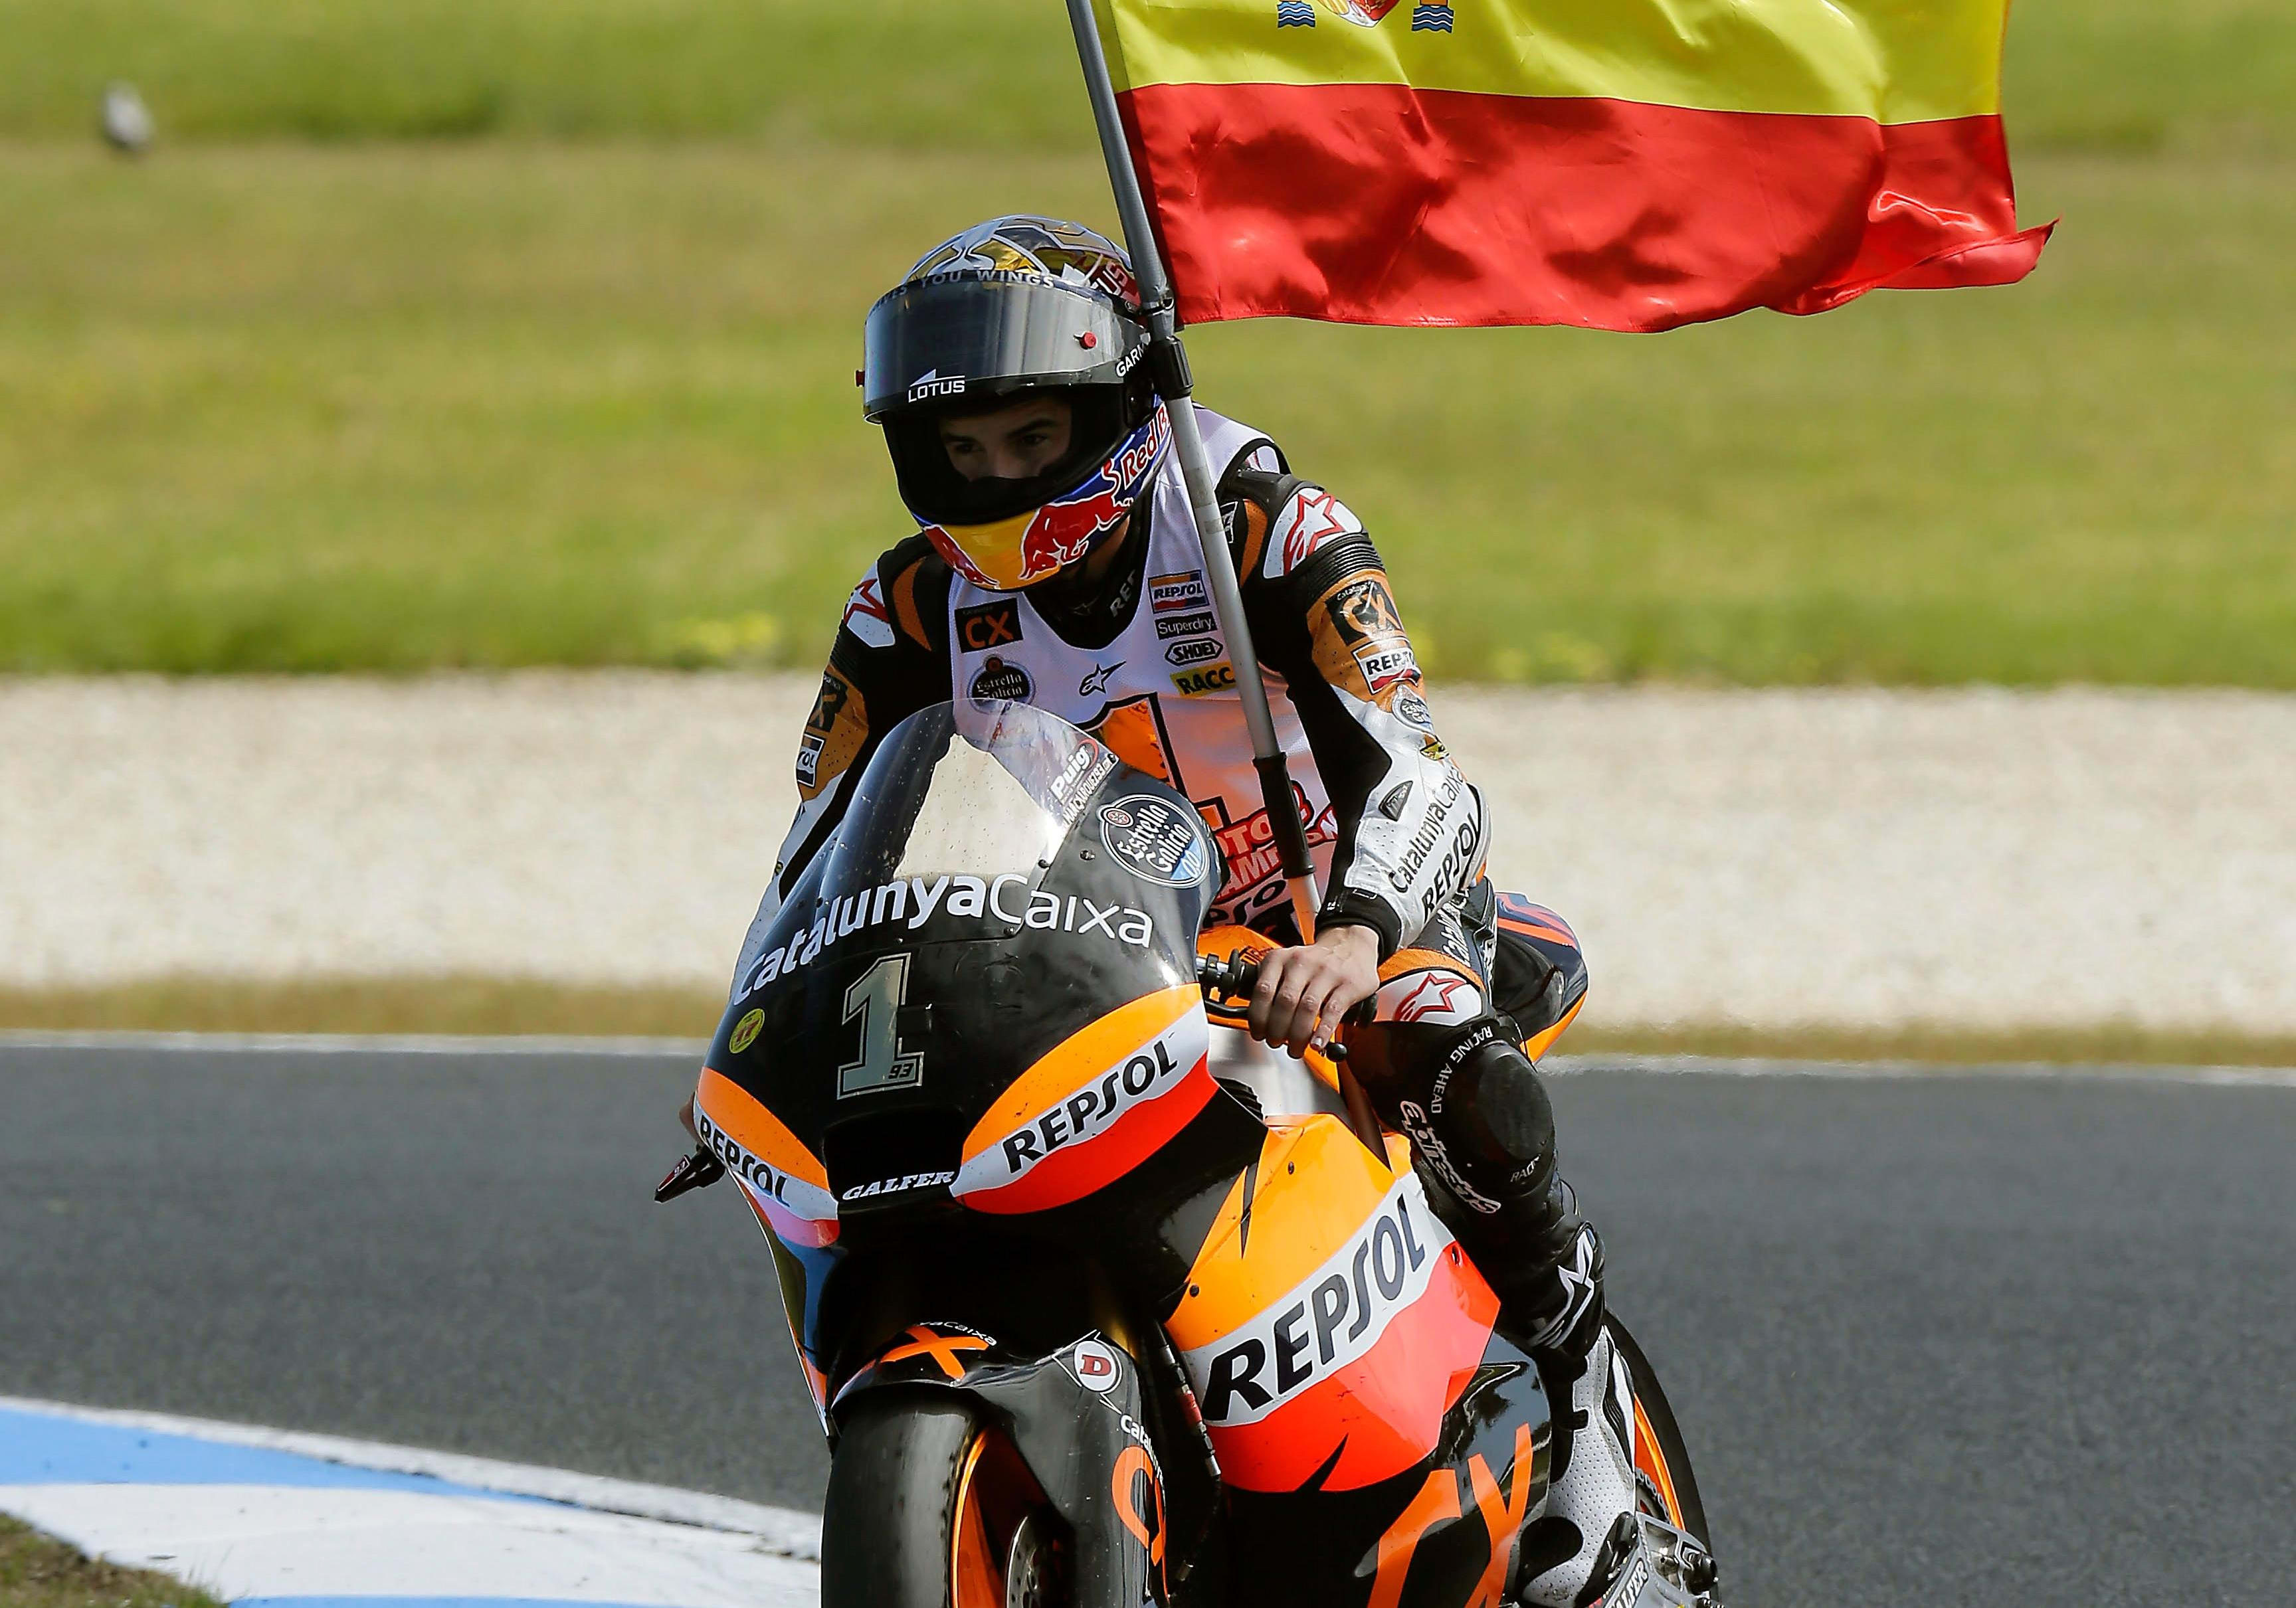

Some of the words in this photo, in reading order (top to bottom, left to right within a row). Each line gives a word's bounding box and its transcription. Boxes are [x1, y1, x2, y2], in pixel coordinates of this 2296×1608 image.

[921, 270, 963, 288] YOU
[977, 270, 1056, 288] WINGS
[908, 381, 965, 402] LOTUS
[1154, 582, 1203, 598] REPSOL
[965, 610, 1014, 649] CX
[1173, 641, 1216, 662] SHOEI
[1176, 666, 1235, 694] RACC
[1050, 744, 1090, 800] Puig
[1116, 804, 1170, 863] Estrella
[1146, 824, 1192, 873] Galicia
[1421, 812, 1481, 925] REPSOL
[733, 874, 1153, 1005] CatalunyaCaixa
[837, 952, 925, 1100] 1
[1450, 1026, 1493, 1063] RACING
[888, 1063, 914, 1079] 93
[1431, 1063, 1453, 1113] AHEAD
[1001, 1040, 1179, 1174] REPSOL
[700, 1115, 792, 1207] REPSOL
[842, 1171, 955, 1200] GALFER
[1202, 1194, 1426, 1421] REPSOL
[1080, 1354, 1111, 1376] D
